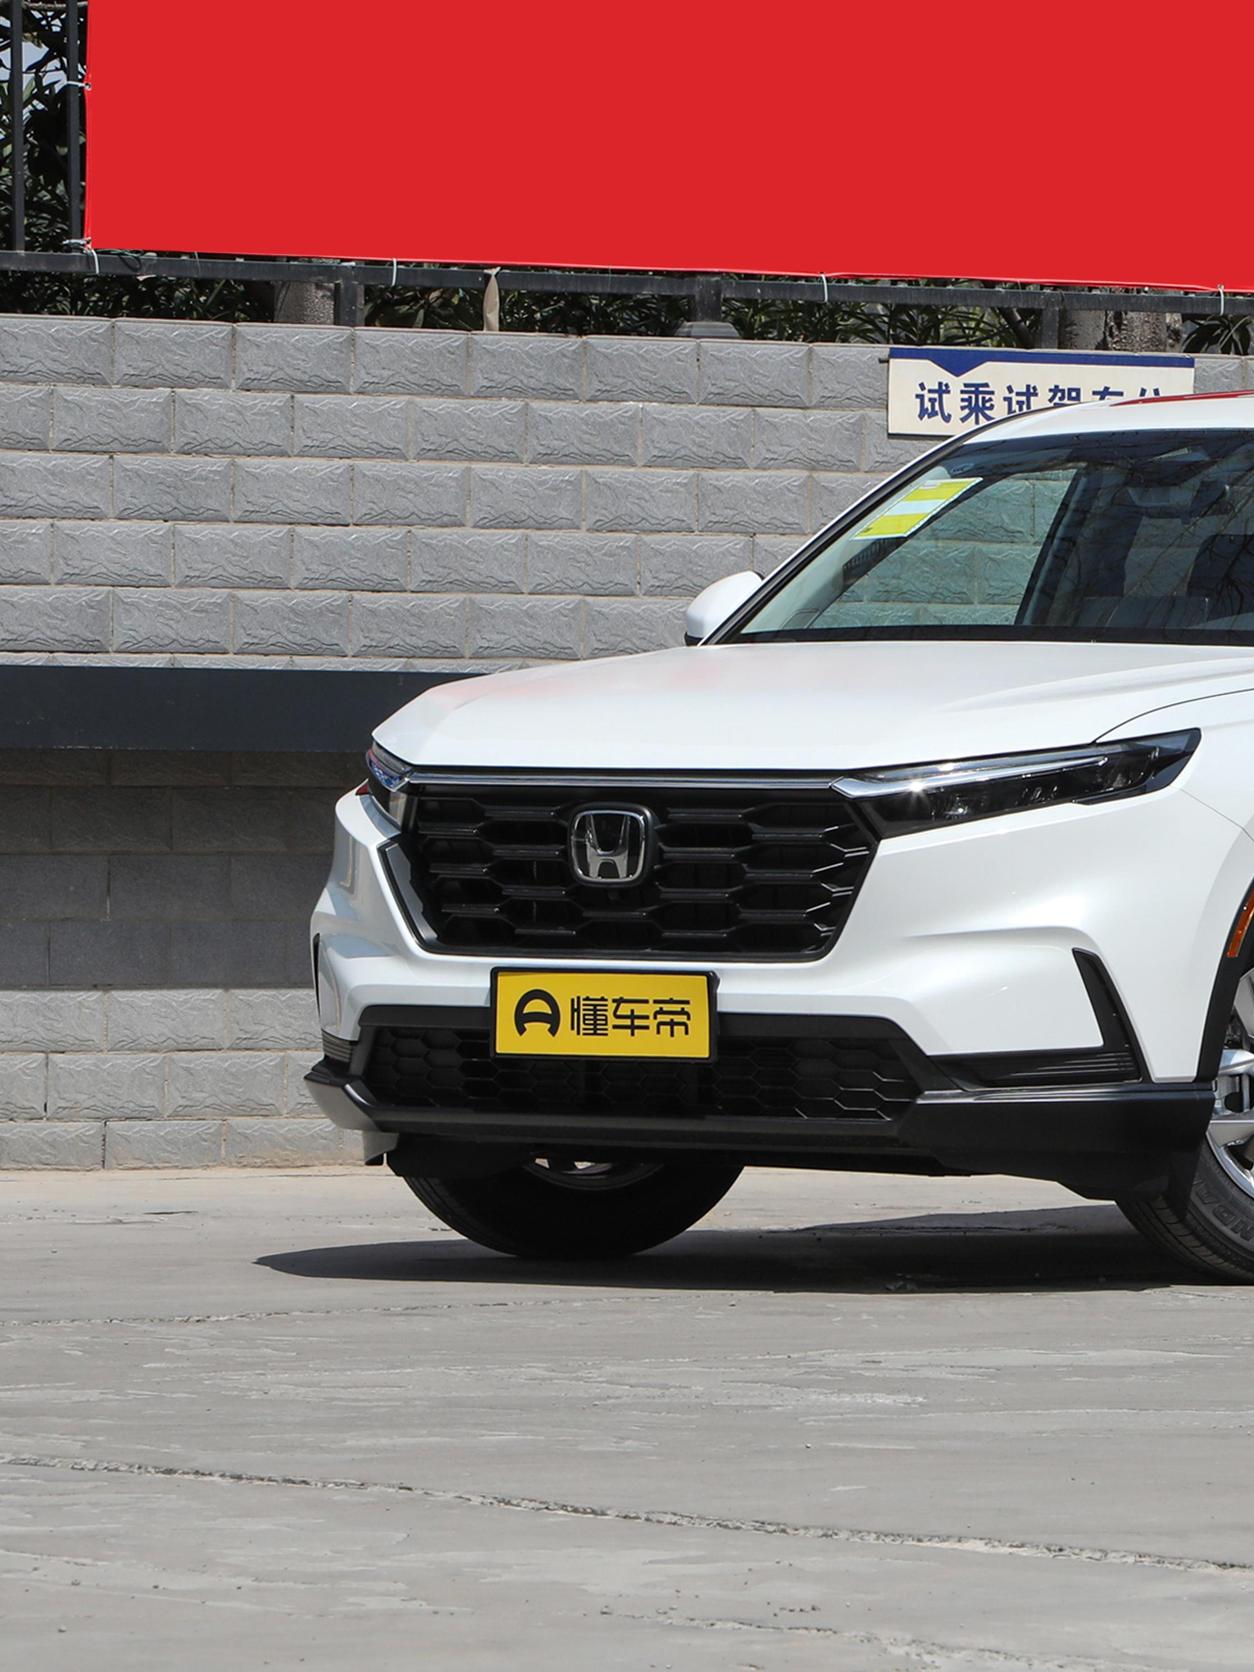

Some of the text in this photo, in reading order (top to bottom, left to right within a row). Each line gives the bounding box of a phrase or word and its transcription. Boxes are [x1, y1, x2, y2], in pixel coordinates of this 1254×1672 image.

[915, 381, 1160, 425] 试乘试驾
[570, 995, 692, 1038] 懂车帝
